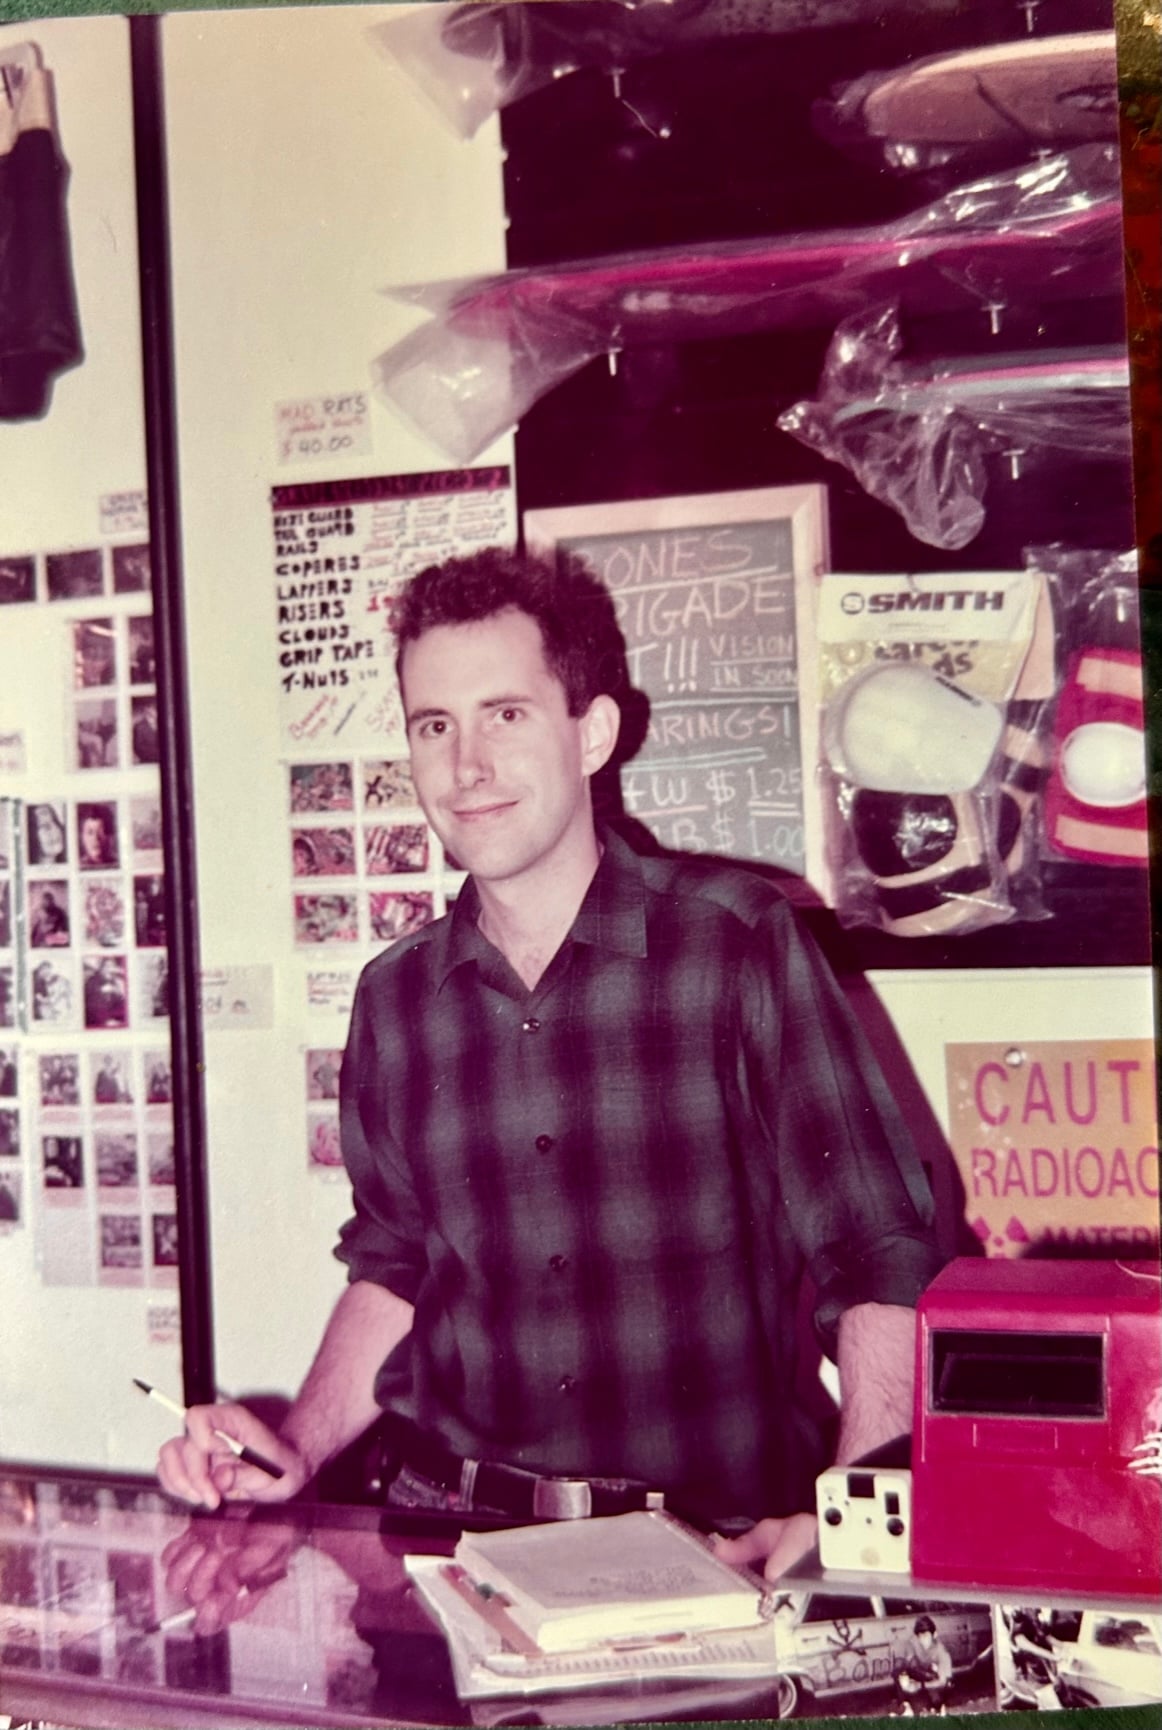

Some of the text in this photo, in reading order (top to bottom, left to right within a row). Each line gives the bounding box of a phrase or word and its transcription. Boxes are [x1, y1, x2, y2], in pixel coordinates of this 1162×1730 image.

[276, 578, 352, 601] LAPPERS
[867, 590, 1005, 614] SMITH
[278, 599, 346, 624] RISERS
[278, 624, 350, 646] CLOUDS
[709, 633, 794, 658] VISION
[279, 639, 375, 668] GRIP TAPE
[713, 665, 741, 687] IN
[973, 1059, 1142, 1127] CAUT
[971, 1146, 1158, 1198] RADIOAC
